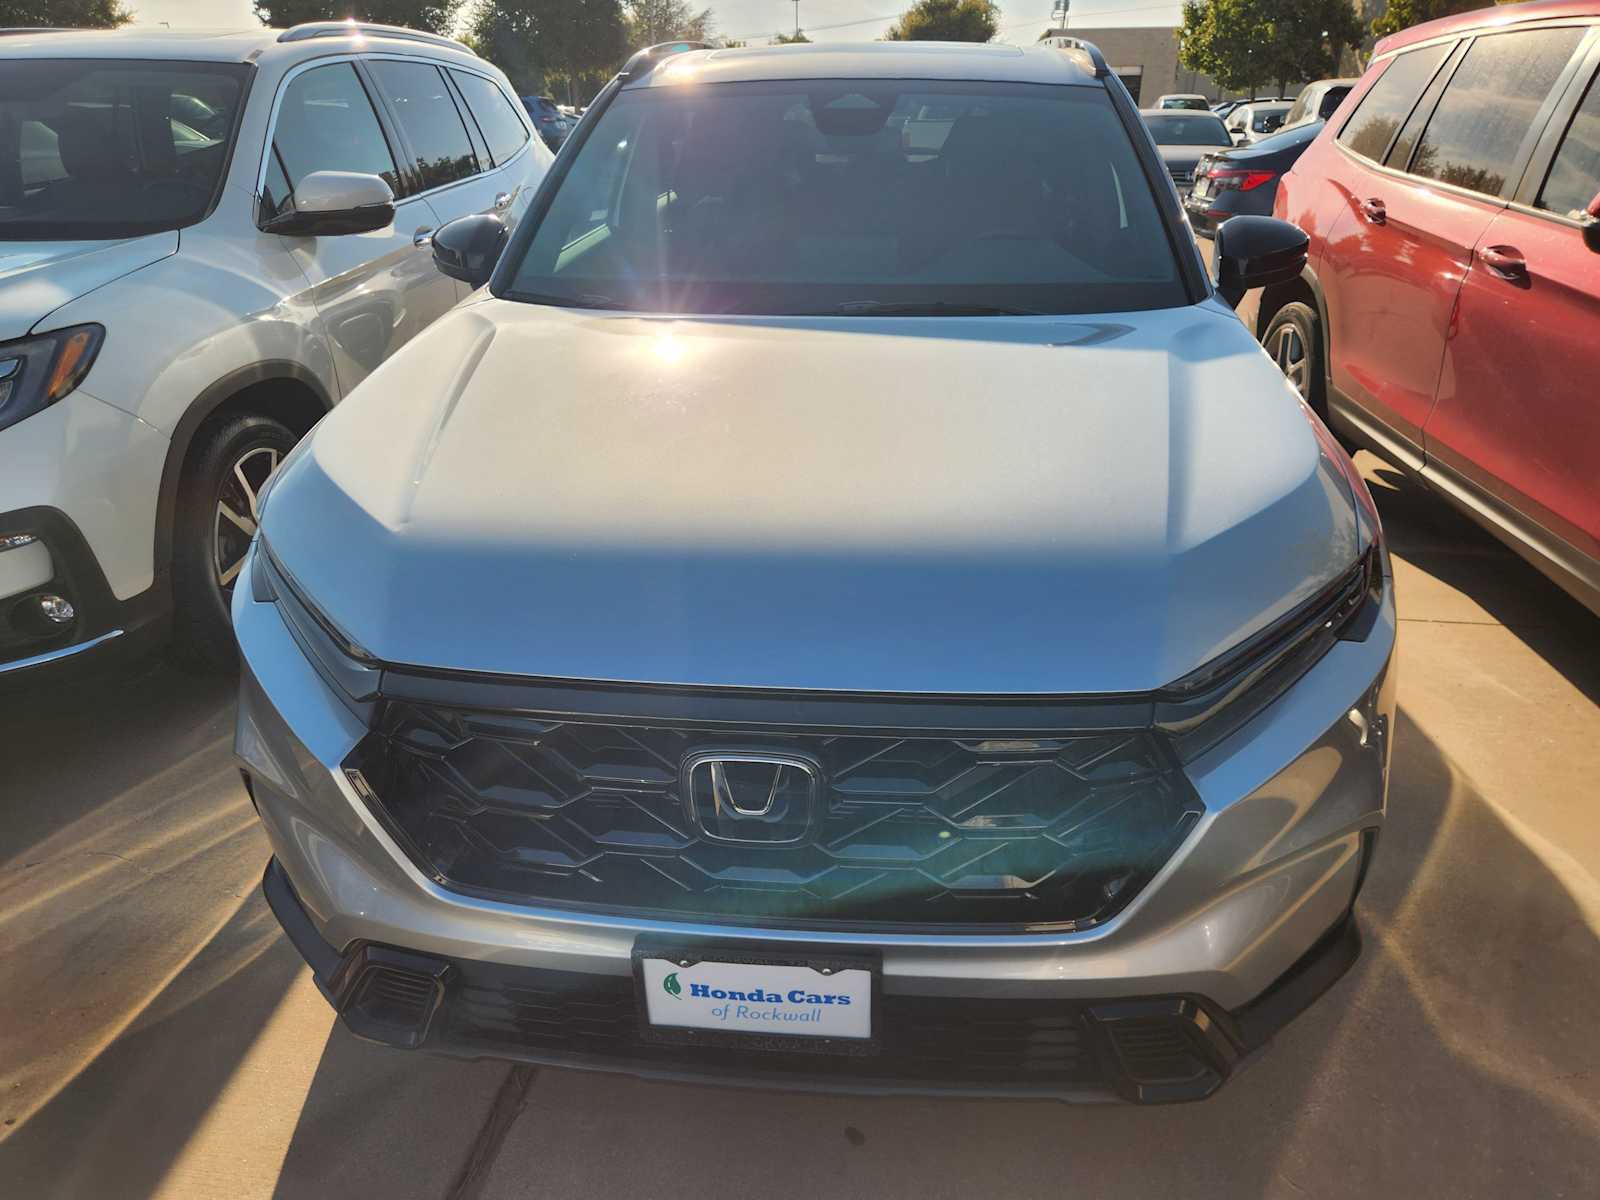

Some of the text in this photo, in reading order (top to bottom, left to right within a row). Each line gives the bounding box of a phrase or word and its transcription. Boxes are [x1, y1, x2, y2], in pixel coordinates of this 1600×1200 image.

[690, 983, 851, 1005] Honda Cars
[711, 1004, 822, 1023] of Rockwall
